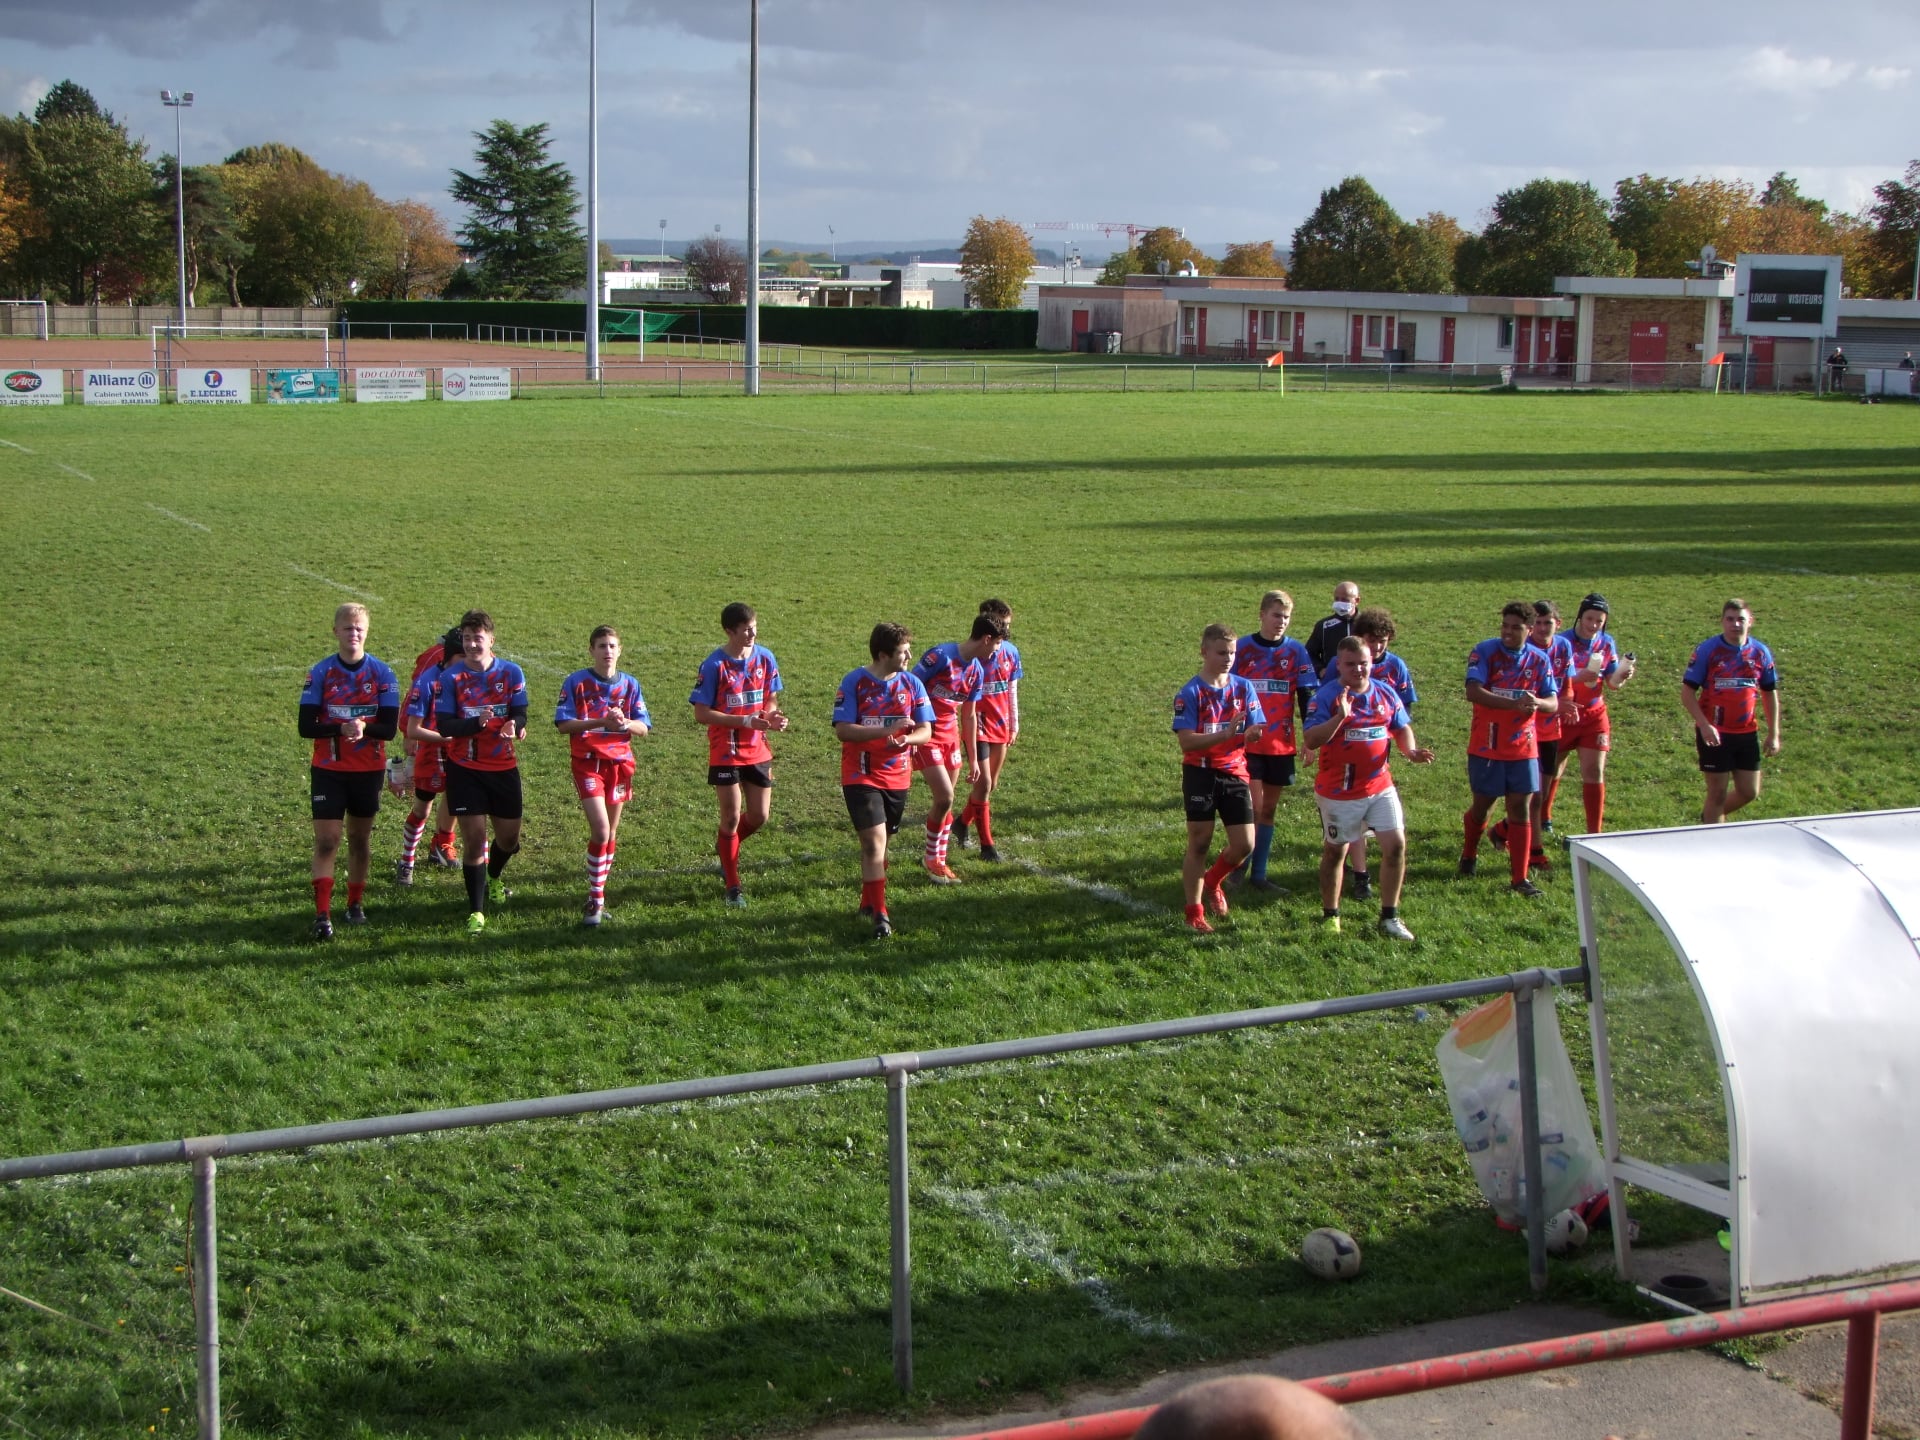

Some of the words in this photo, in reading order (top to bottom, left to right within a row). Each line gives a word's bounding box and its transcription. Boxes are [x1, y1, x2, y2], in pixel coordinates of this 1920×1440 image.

[1751, 293, 1777, 304] LOCAUX
[1788, 294, 1823, 305] VISITEURS
[89, 374, 135, 386] Allianz
[191, 390, 237, 398] E.LECLERC
